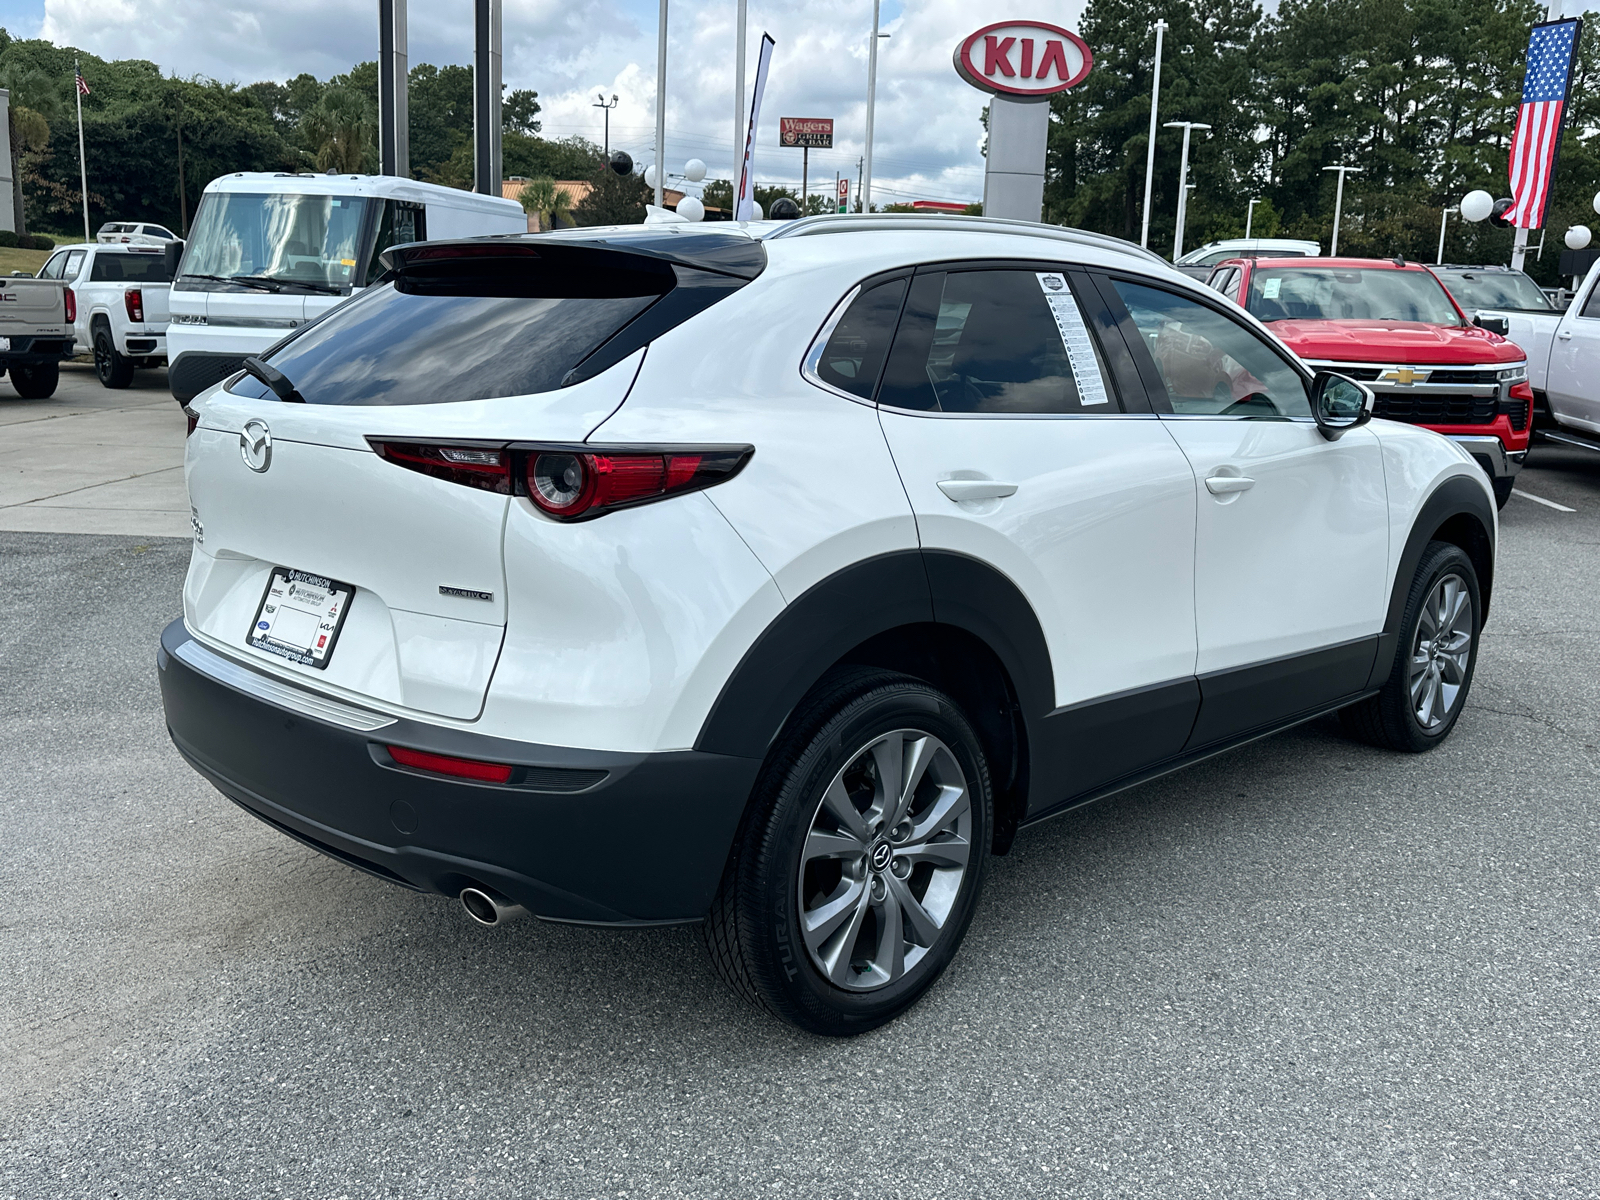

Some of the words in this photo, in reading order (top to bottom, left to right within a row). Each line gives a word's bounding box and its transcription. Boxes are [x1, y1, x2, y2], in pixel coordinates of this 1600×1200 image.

[984, 36, 1070, 80] KIA
[784, 119, 831, 133] Wagers
[294, 572, 331, 588] HUTCHINSON
